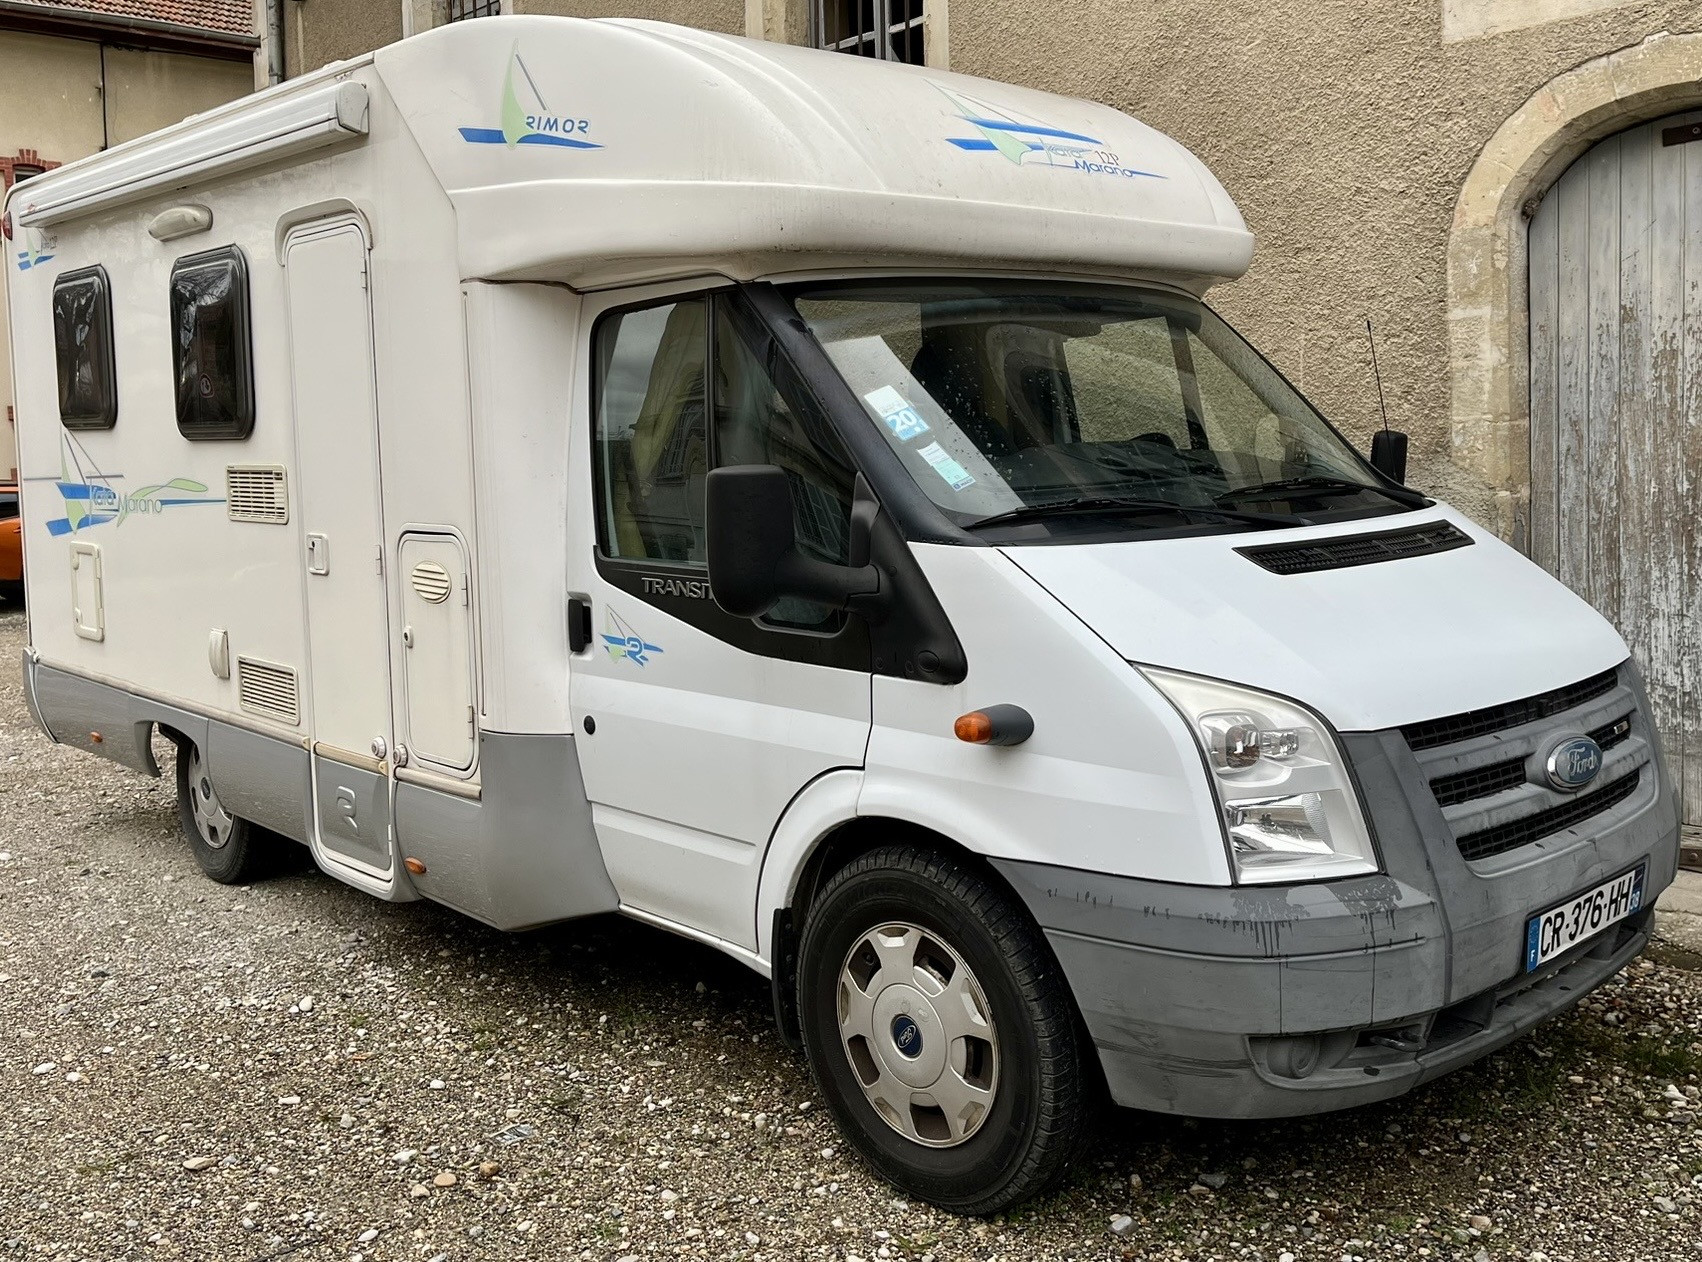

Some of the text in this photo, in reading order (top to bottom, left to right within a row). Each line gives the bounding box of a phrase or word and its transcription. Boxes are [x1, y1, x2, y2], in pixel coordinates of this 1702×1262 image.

[525, 115, 589, 134] RIMOR
[1074, 159, 1134, 178] Marano
[1567, 746, 1599, 776] Ford
